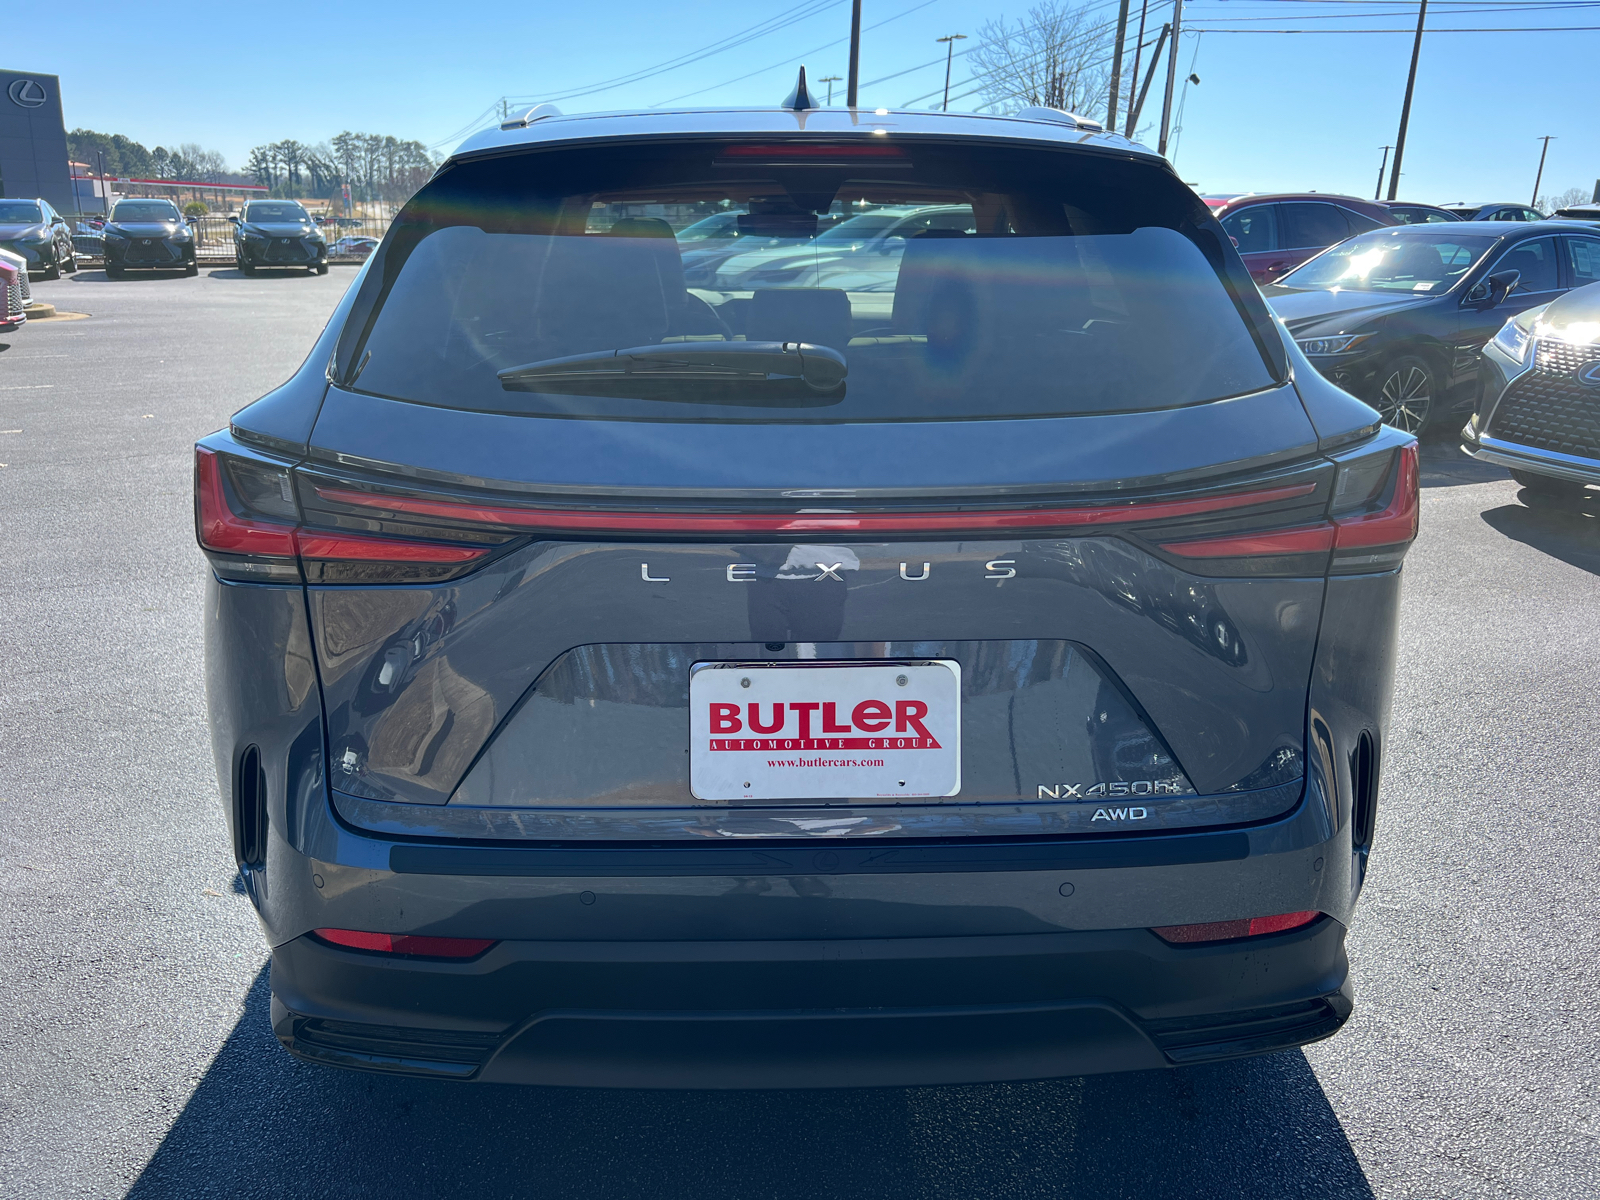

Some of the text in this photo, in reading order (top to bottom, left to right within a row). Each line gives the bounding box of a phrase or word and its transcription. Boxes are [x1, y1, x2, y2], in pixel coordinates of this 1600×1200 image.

[640, 560, 1016, 583] LEXUS
[711, 737, 933, 750] AUTOMOTIVE GROUP
[767, 757, 884, 768] www.butlercars.com
[1091, 806, 1148, 822] AWD
